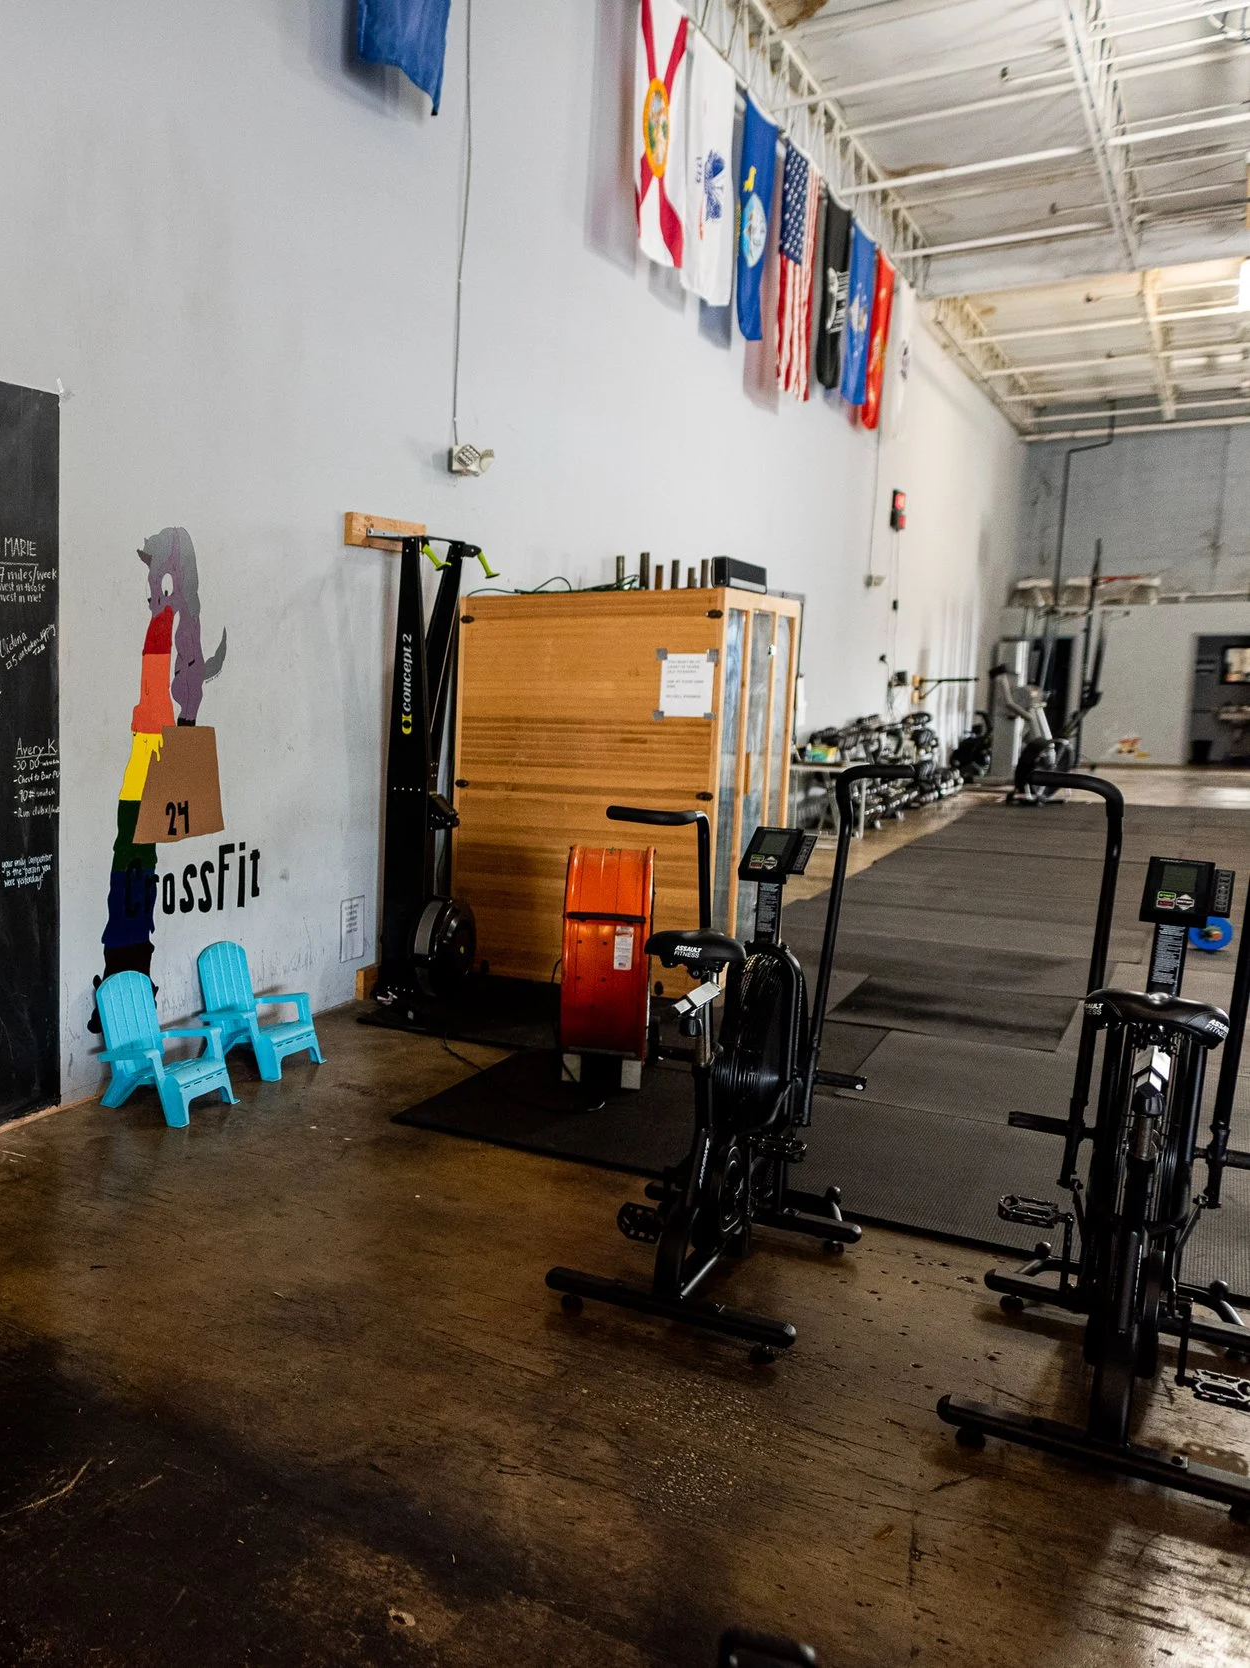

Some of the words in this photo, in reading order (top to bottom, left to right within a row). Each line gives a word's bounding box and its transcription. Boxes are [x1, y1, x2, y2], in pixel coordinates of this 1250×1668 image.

[5, 537, 37, 556] MARIE
[16, 584, 23, 592] in
[402, 633, 412, 643] 2
[402, 646, 413, 712] concept
[16, 737, 44, 760] Avery
[48, 739, 57, 753] K
[16, 760, 26, 771] 30
[165, 800, 189, 836] 24
[125, 842, 260, 918] CrossFit
[675, 945, 702, 953] ASSAULT
